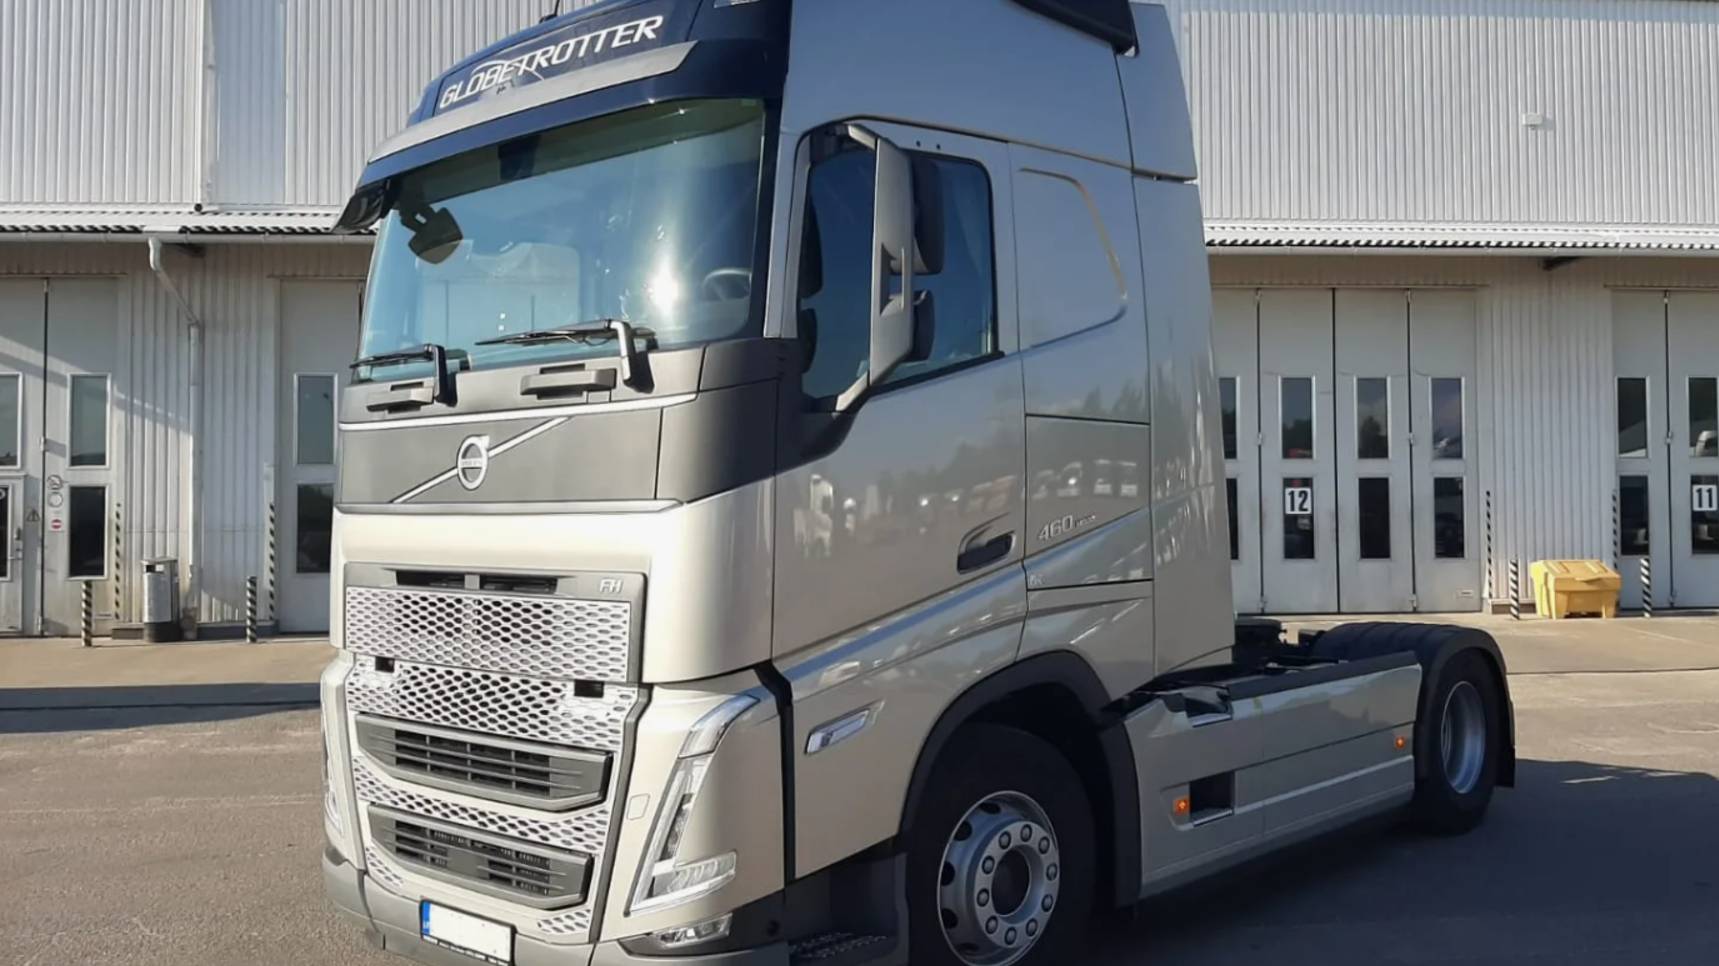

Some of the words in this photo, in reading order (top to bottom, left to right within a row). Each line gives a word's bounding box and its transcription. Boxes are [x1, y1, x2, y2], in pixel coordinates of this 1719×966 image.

[440, 15, 663, 109] GLOBETROTTER
[1288, 490, 1308, 512] 12
[1696, 487, 1712, 508] 11
[1038, 515, 1073, 540] 460
[600, 579, 622, 592] FH
